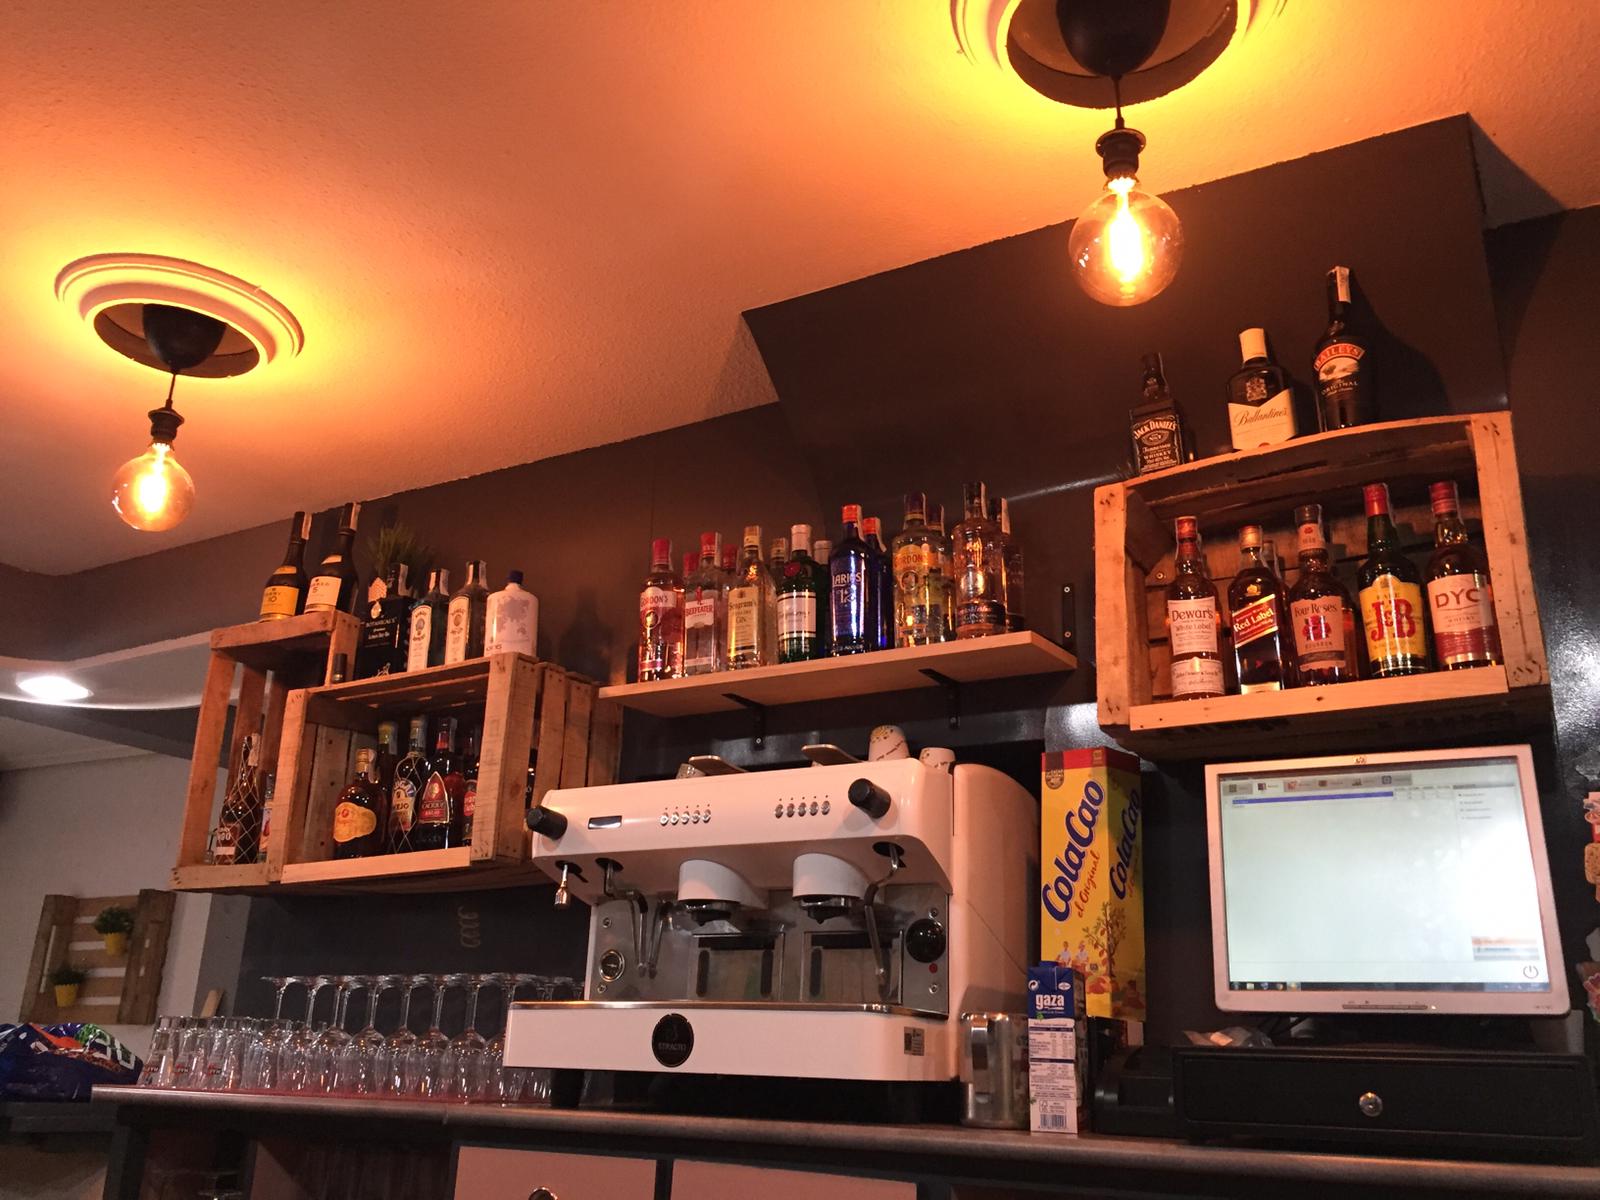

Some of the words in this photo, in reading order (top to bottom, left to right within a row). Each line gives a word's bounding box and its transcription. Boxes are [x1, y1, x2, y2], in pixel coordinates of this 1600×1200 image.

[1315, 345, 1359, 368] BAILEYS
[1236, 407, 1289, 426] Ballantine's
[1133, 424, 1151, 440] JACK
[640, 595, 669, 608] ORDON'S
[1435, 588, 1480, 609] DYC
[1171, 609, 1214, 622] Dewar's
[1233, 619, 1251, 633] Red
[1250, 607, 1274, 624] Label
[1294, 606, 1310, 618] Four
[1080, 850, 1101, 905] Original
[1035, 994, 1065, 1010] gaza
